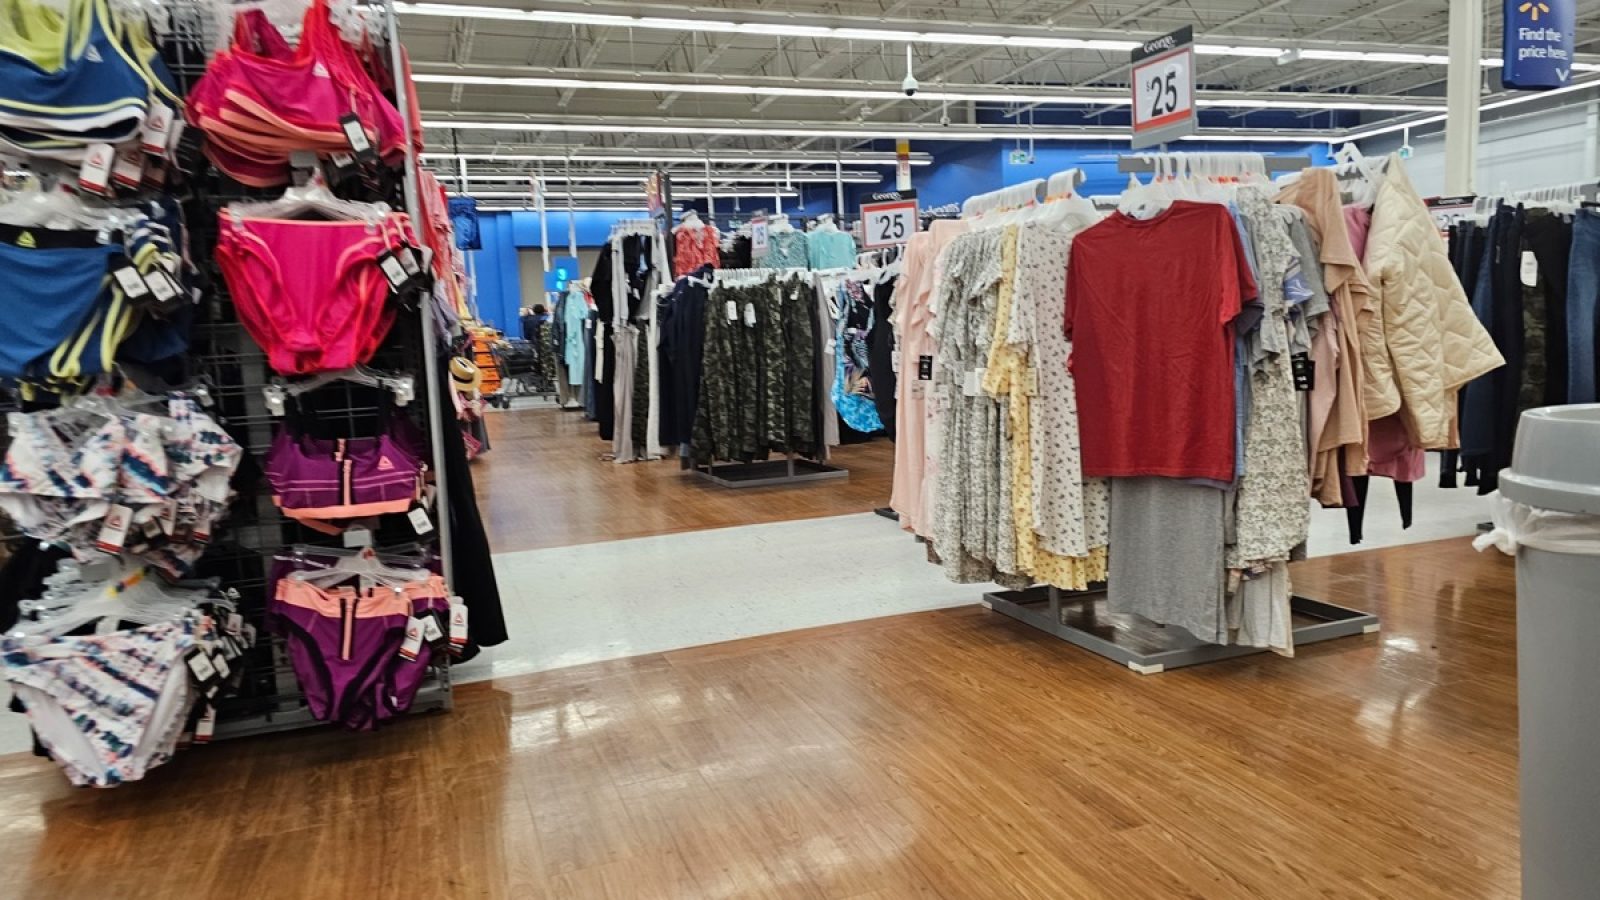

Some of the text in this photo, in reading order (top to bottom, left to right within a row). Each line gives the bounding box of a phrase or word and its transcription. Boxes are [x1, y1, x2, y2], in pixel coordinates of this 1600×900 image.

[1519, 27, 1562, 42] Find the
[1518, 44, 1547, 61] price
